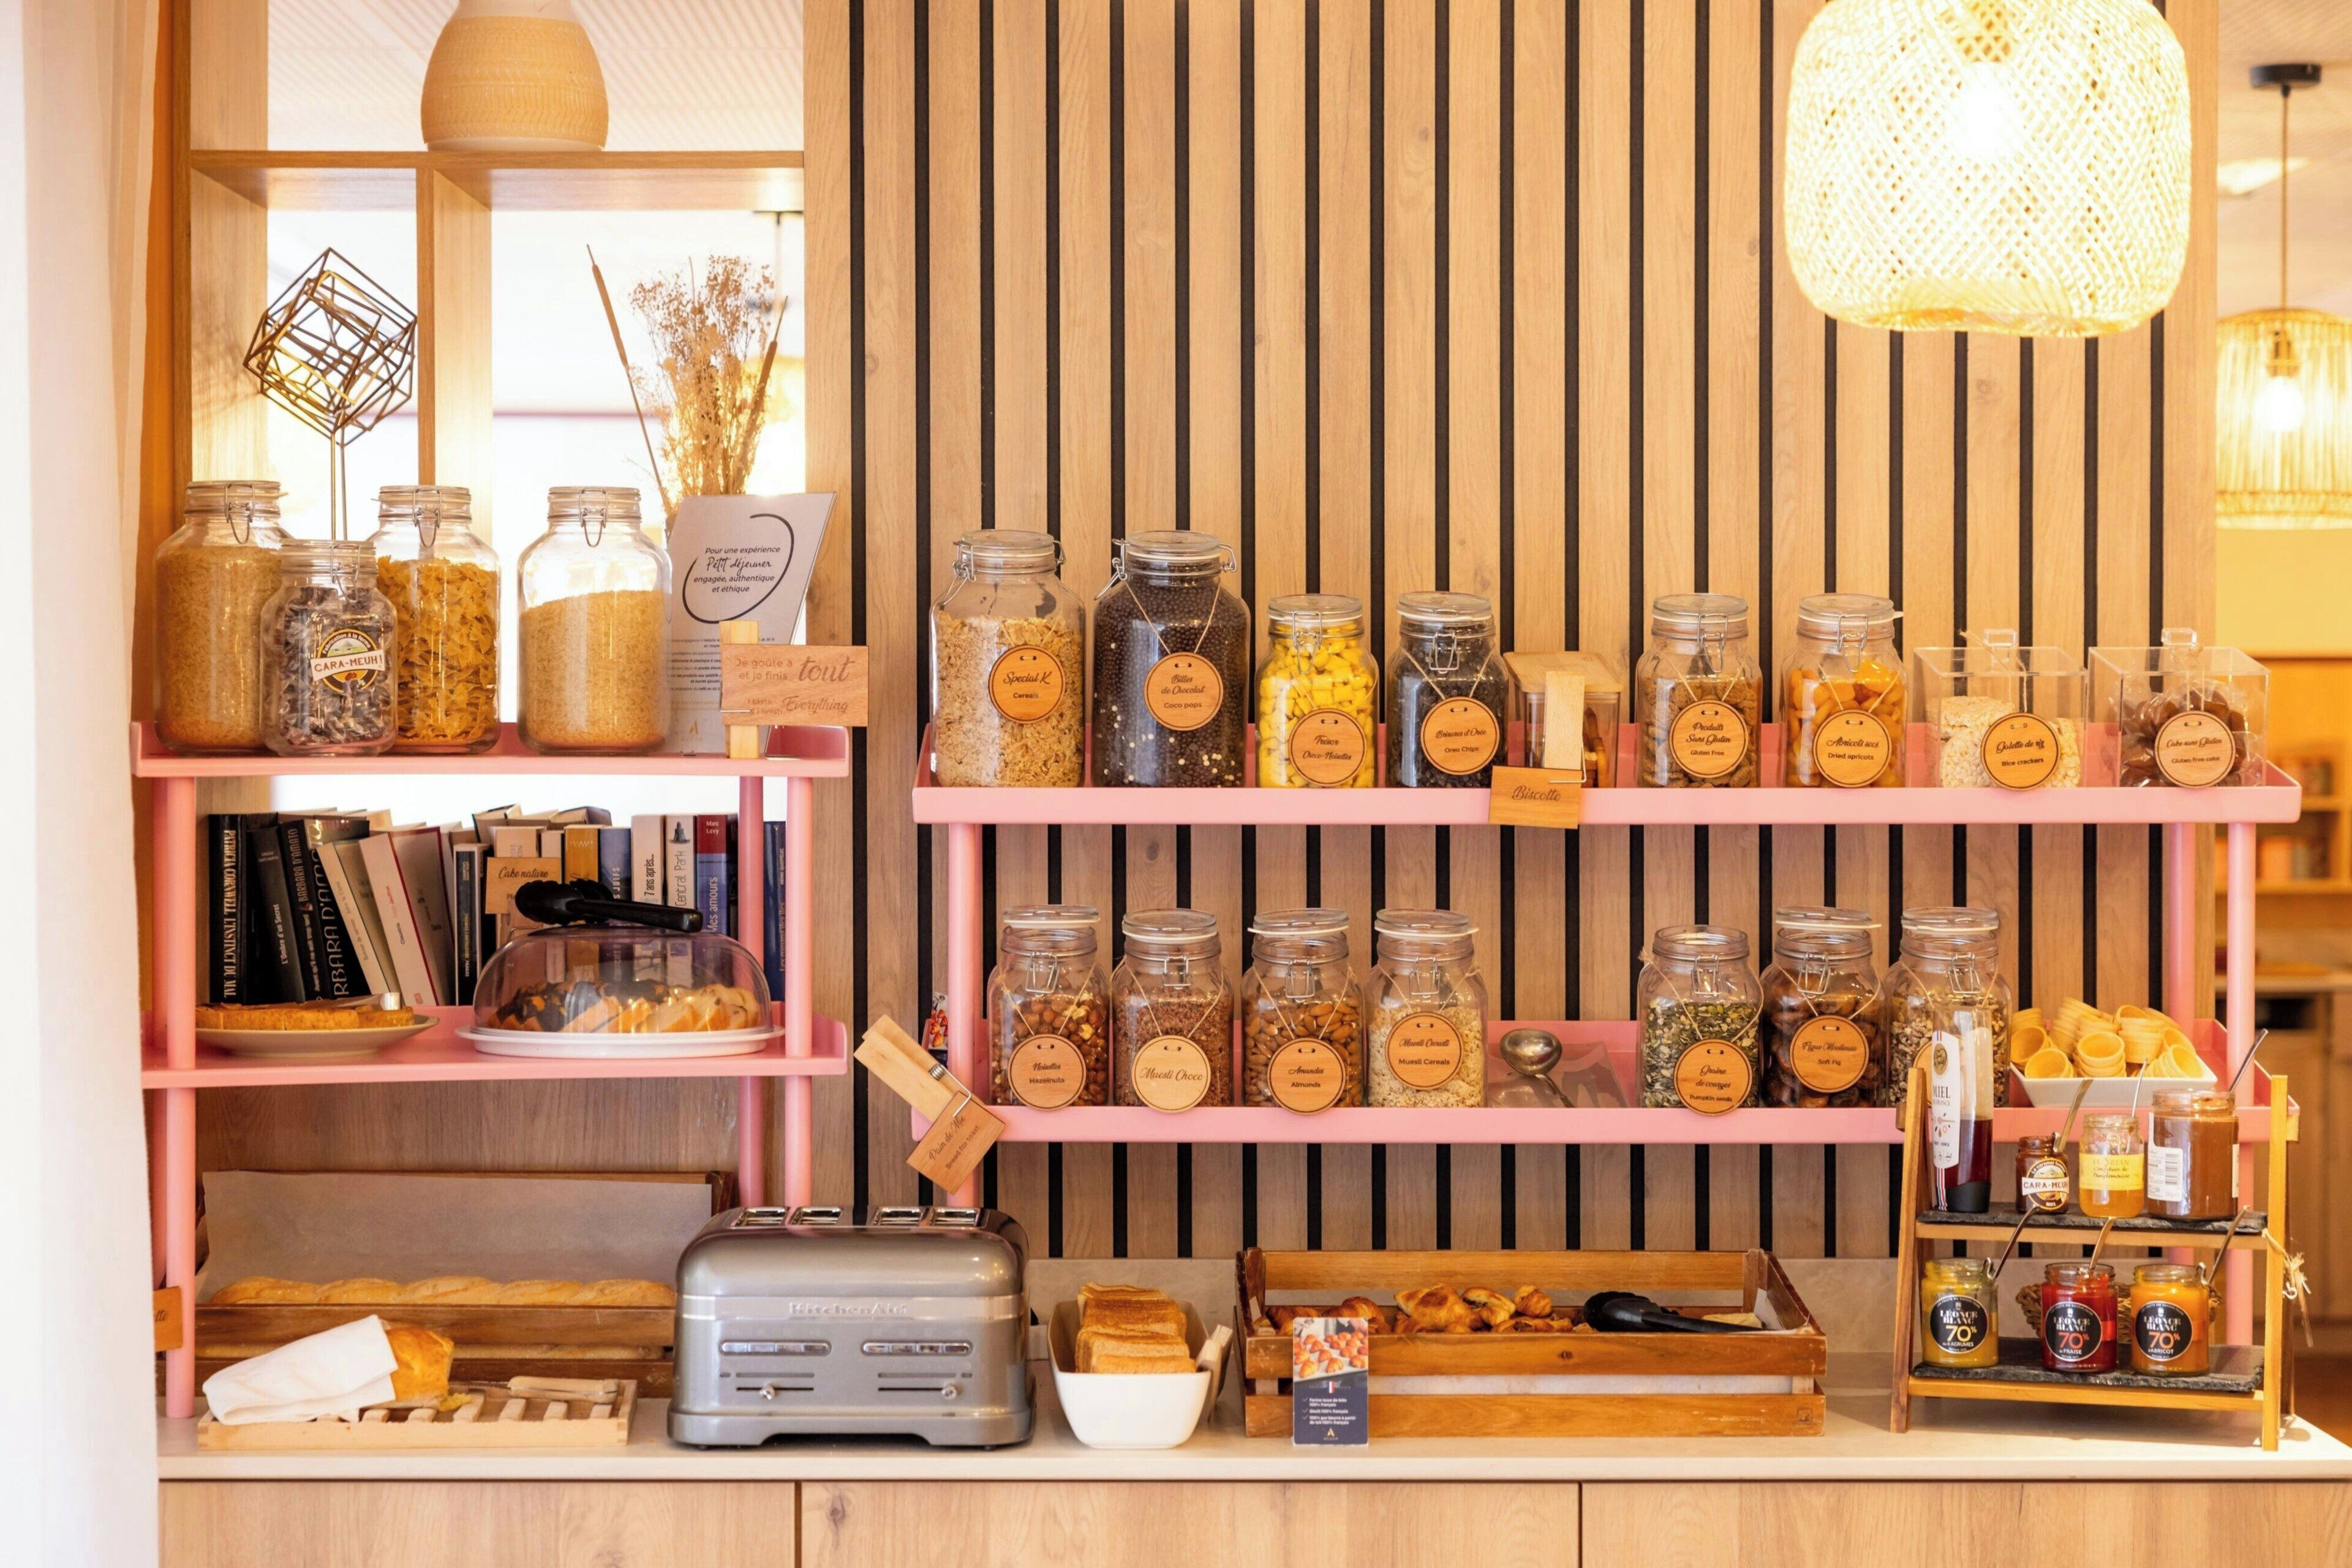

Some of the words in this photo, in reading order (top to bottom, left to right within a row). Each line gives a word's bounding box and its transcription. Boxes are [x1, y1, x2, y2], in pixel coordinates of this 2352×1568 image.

[707, 557, 731, 572] Petit
[730, 557, 772, 576] déjeuner
[729, 575, 774, 584] authentique
[722, 586, 750, 594] éthique
[322, 633, 347, 654] Fabrication
[358, 636, 371, 649] ferme
[736, 658, 748, 668] Je
[751, 657, 783, 669] goûte
[786, 657, 793, 667] à
[799, 656, 856, 682] tout
[739, 671, 750, 680] et
[752, 671, 763, 682] je
[765, 671, 788, 680] finis
[1003, 671, 1039, 685] Special
[1039, 671, 1052, 684] K
[1171, 674, 1193, 684] Billes
[1172, 685, 1206, 695] Chocolat
[782, 696, 848, 715] Everything
[1436, 730, 1463, 739] Brisures
[1686, 734, 1705, 743] Sans
[1705, 734, 1731, 745] Gluten
[1826, 736, 1864, 748] Abricots
[1996, 740, 2024, 754] Galette
[2035, 739, 2045, 750] riz
[2166, 739, 2184, 748] Cake
[2199, 737, 2222, 747] Gluten
[1303, 750, 1352, 760] Choco-Noisettes
[1512, 785, 1562, 802] Biscotte
[224, 830, 236, 867] PATRICIA
[288, 829, 301, 864] D'AMATO
[674, 851, 686, 871] Park
[499, 867, 520, 879] Cake
[521, 868, 549, 878] nature
[293, 865, 308, 902] BARBARA
[646, 879, 655, 891] ans
[224, 868, 236, 914] CORNWELL
[674, 875, 687, 908] Central
[709, 877, 718, 911] amours
[273, 903, 282, 923] Secret
[707, 912, 718, 932] Mes
[276, 924, 285, 938] d'un
[224, 918, 236, 963] L'INSTINCT
[279, 939, 288, 965] L'Ombre
[323, 926, 350, 997] RBARA
[224, 965, 236, 978] DU
[224, 979, 236, 998] MAL
[1399, 1038, 1425, 1047] Muesli
[1802, 1041, 1823, 1052] Figue
[1823, 1042, 1857, 1052] Moelleuse
[1033, 1062, 1061, 1071] Noisettes
[1140, 1066, 1174, 1080] Muesli
[1175, 1069, 1203, 1081] Choco
[1288, 1066, 1324, 1075] Amandes
[1700, 1065, 1727, 1076] Graine
[1695, 1079, 1704, 1087] de
[1705, 1082, 1732, 1091] courges
[929, 1141, 946, 1161] Pain
[944, 1132, 954, 1142] de
[950, 1115, 966, 1133] Mie
[945, 1150, 962, 1169] Bread
[959, 1141, 968, 1152] for
[965, 1125, 981, 1142] toast
[789, 1302, 908, 1316] KitchenAid
[1946, 1325, 1977, 1342] 70%
[2056, 1323, 2087, 1332] BLANC
[2146, 1323, 2177, 1332] BLANC
[2058, 1331, 2090, 1349] 70%
[2149, 1331, 2180, 1349] 70%
